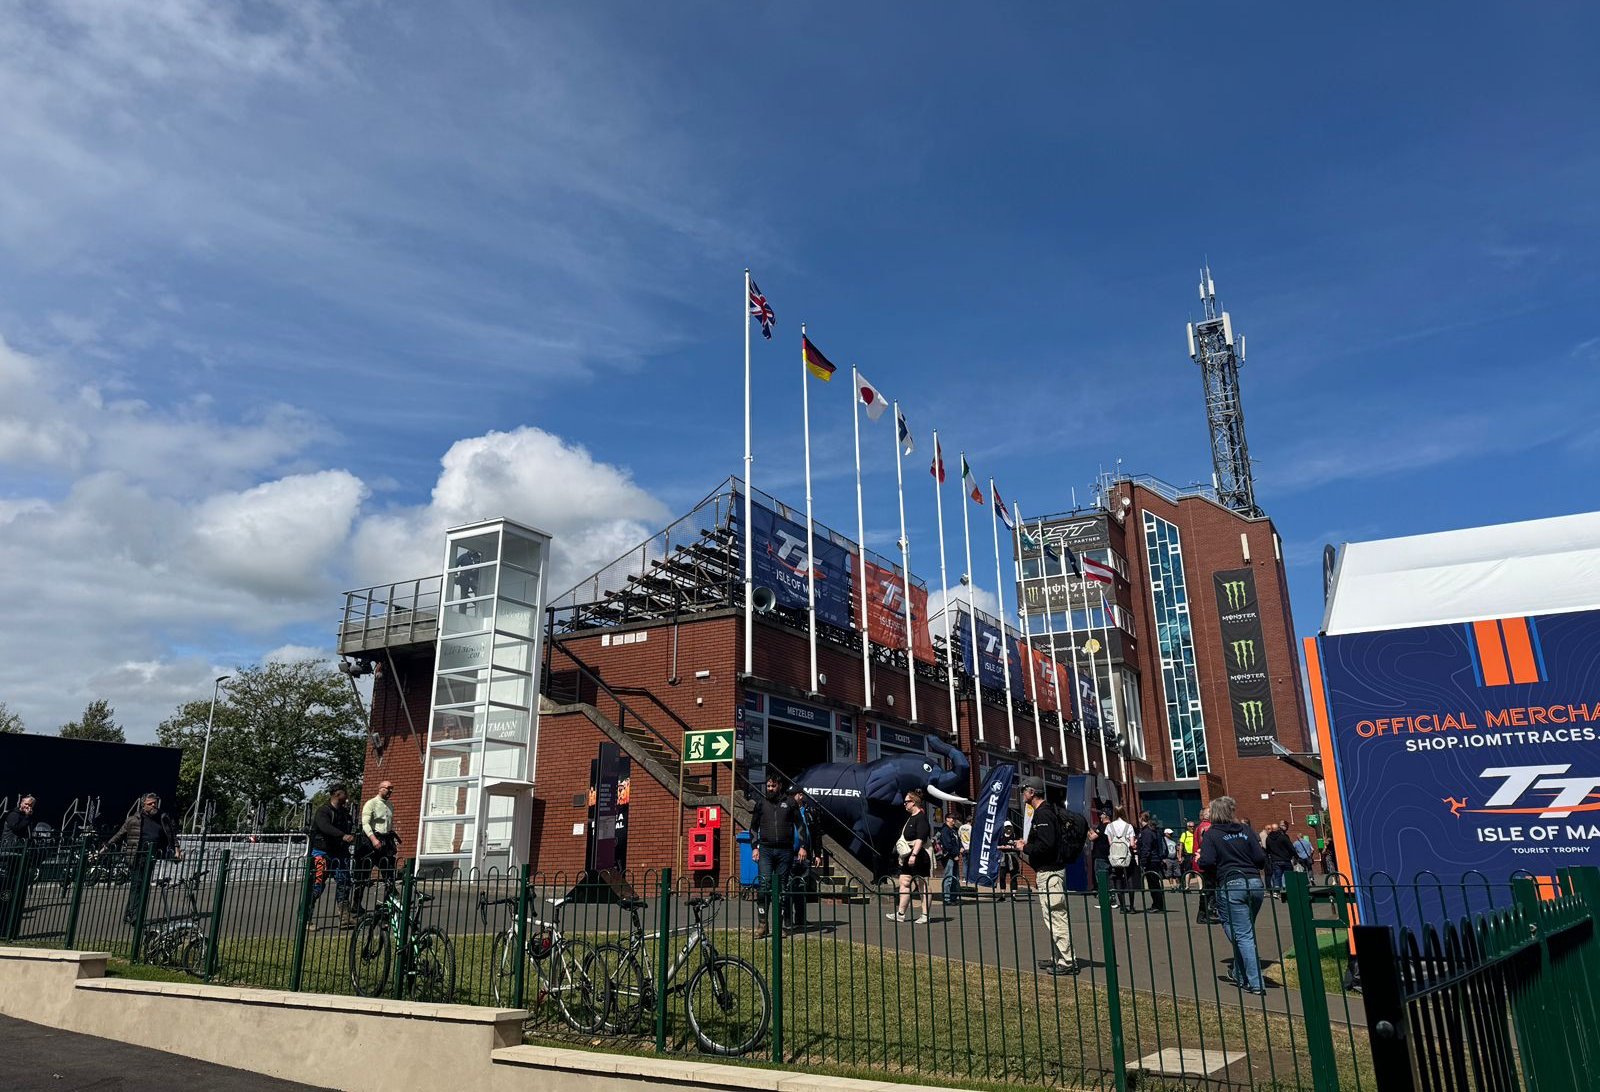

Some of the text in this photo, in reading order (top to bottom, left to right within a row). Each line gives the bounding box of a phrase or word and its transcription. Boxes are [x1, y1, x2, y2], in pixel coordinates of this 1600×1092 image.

[1074, 536, 1100, 544] PARTNER
[776, 569, 791, 586] ISLE
[791, 578, 801, 590] OF
[802, 583, 821, 599] MN
[1041, 579, 1104, 595] MONSTER
[1222, 612, 1257, 621] MONSTER
[1230, 672, 1266, 681] MONSTER
[787, 705, 815, 720] METZELER
[475, 720, 517, 733] LITMANN
[1356, 712, 1477, 738] OFFICIAL
[1239, 735, 1275, 743] MONSTER
[803, 787, 860, 798] METZELER
[1479, 763, 1600, 818] TT
[978, 794, 1000, 875] METZELER
[1477, 826, 1525, 842] ISLE
[1529, 825, 1559, 841] OF
[1552, 846, 1590, 854] TROPHY
